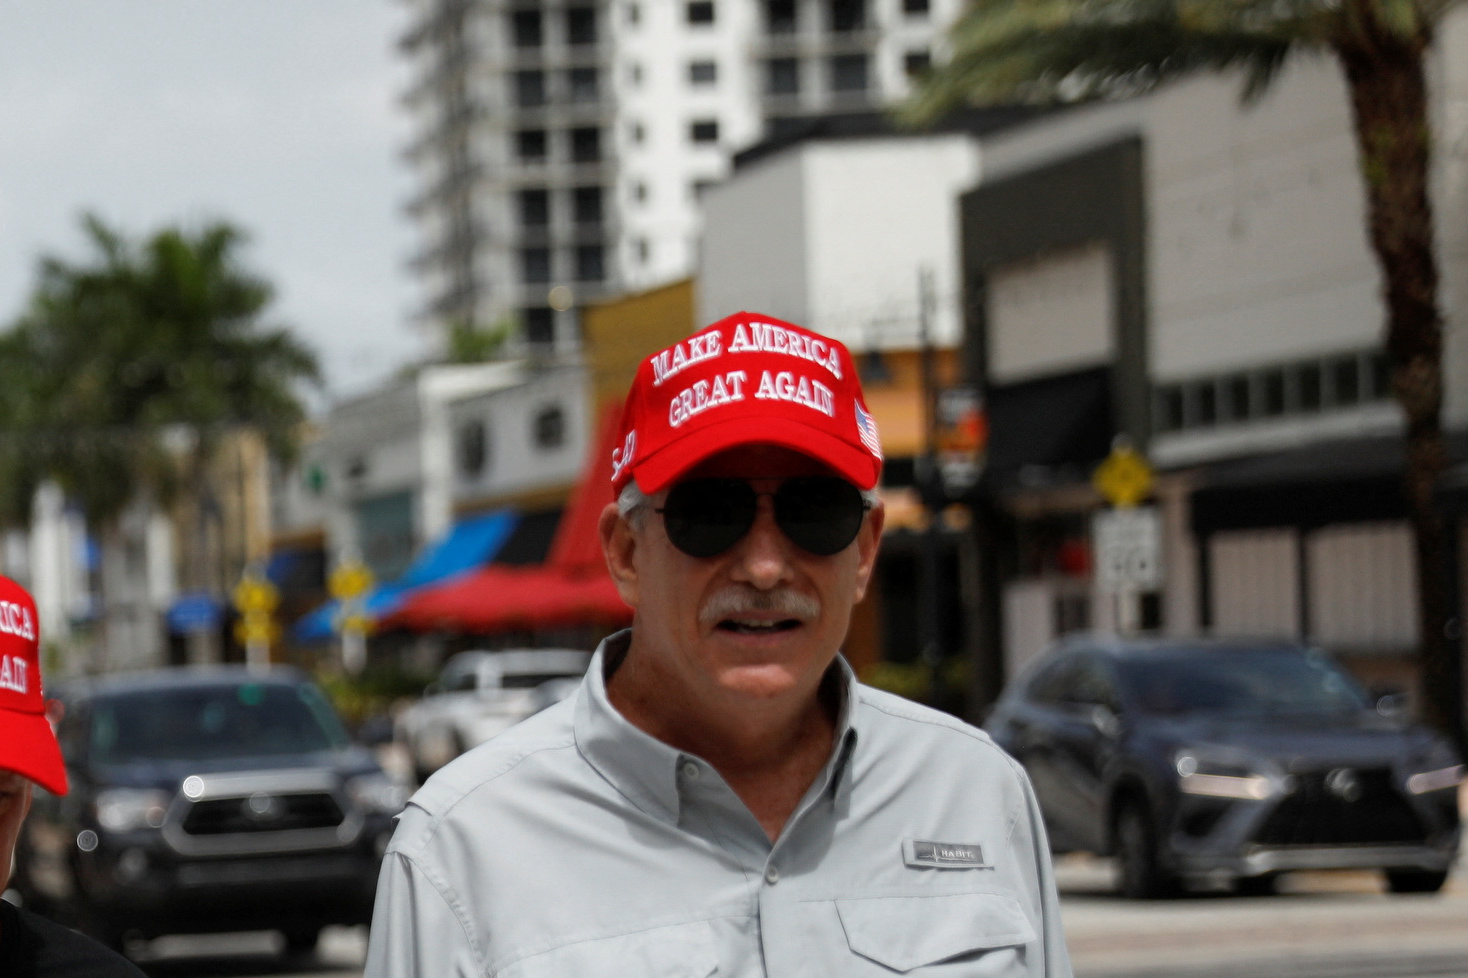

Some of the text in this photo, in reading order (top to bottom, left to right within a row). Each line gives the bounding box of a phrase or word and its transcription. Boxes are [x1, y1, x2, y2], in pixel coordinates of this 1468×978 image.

[651, 322, 843, 386] MAKE AMERICA
[669, 371, 834, 427] GREAT AGAIN
[941, 849, 973, 858] HABIT
